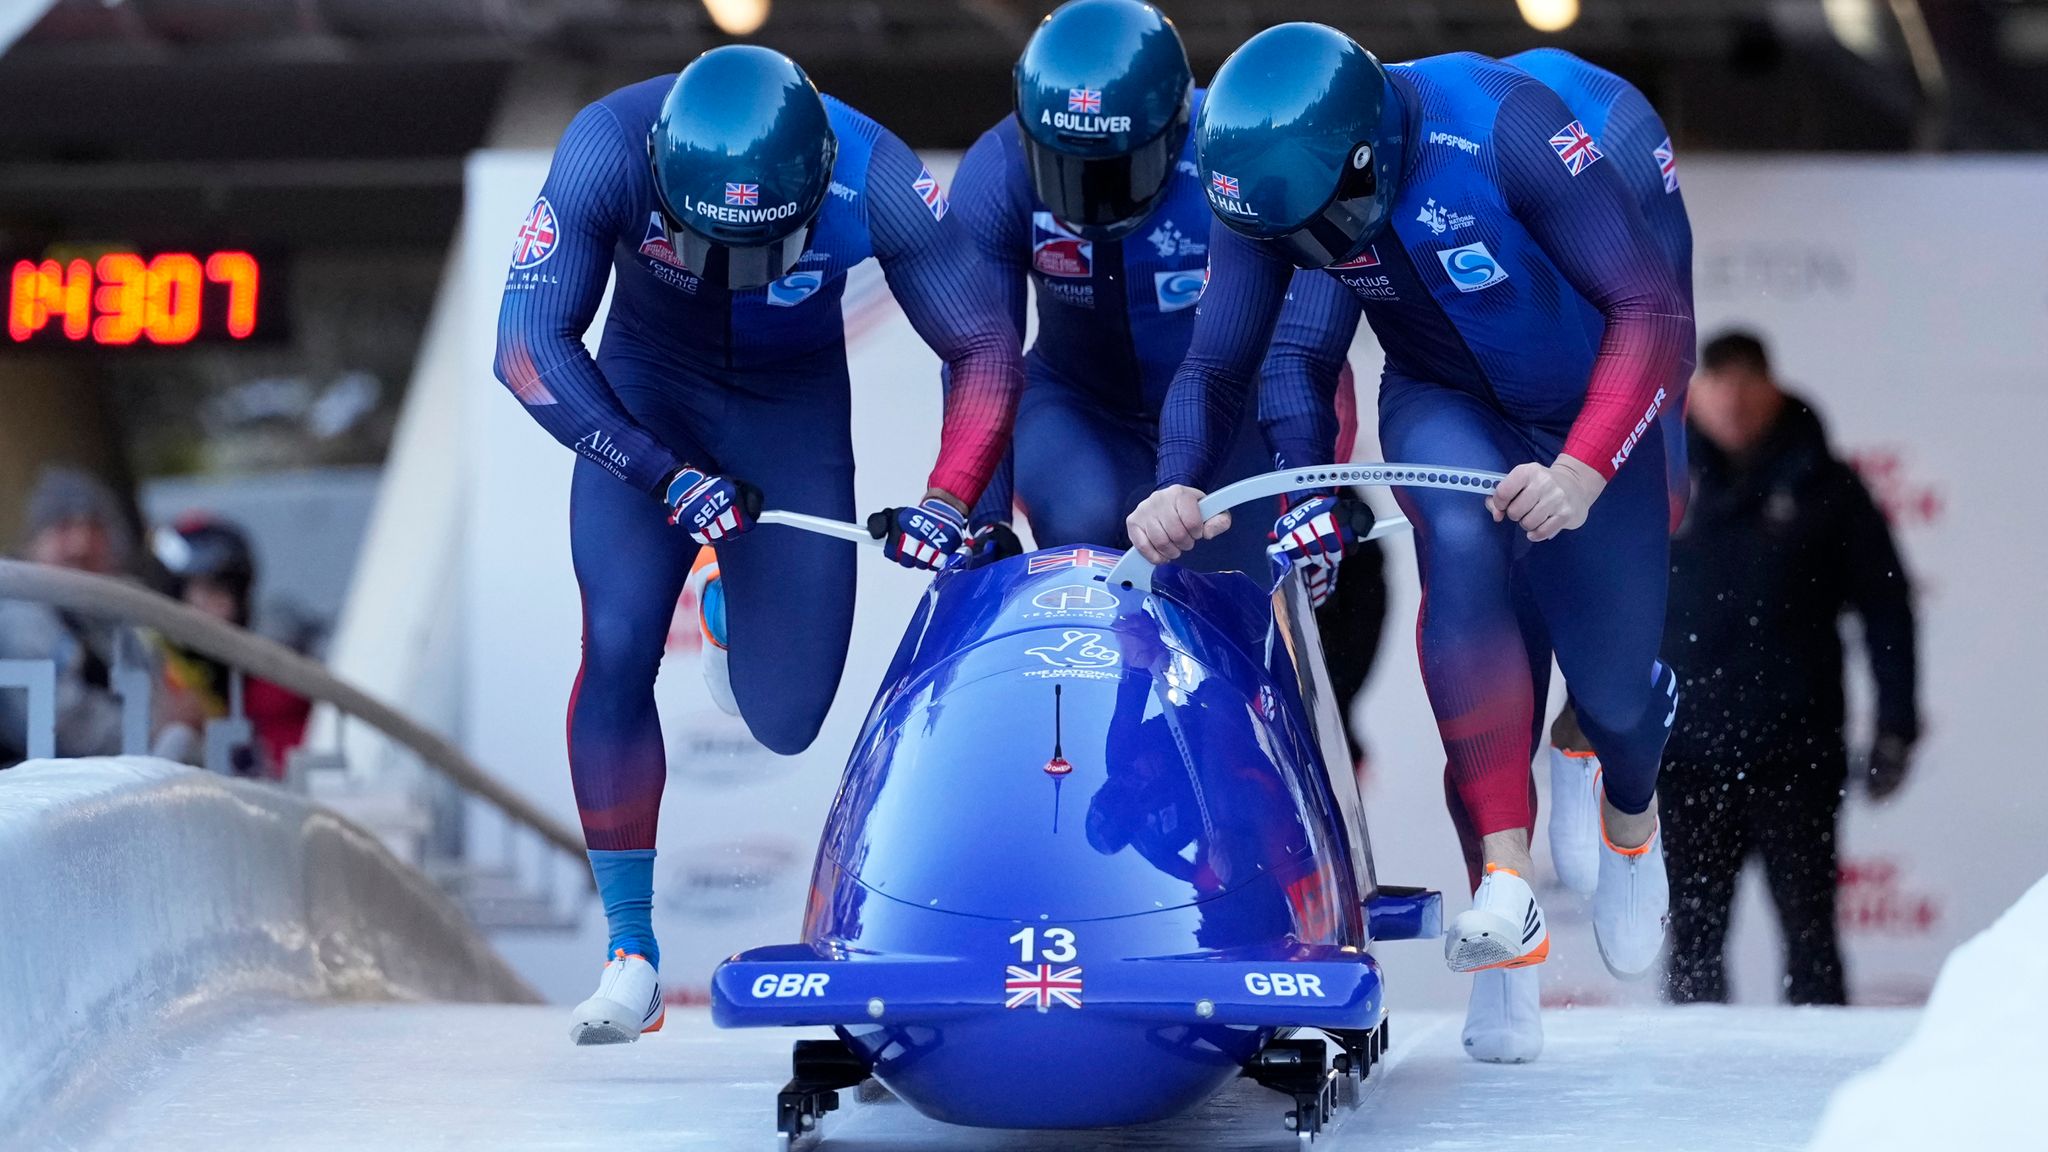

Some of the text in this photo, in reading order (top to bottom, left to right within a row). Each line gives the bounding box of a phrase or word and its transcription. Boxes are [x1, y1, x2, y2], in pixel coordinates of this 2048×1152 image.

[1041, 109, 1132, 133] A GULLIVER
[1430, 131, 1480, 156] IMPSPORT
[685, 194, 797, 223] L GREENWOOD
[1207, 188, 1259, 216] B HALL
[522, 272, 558, 284] HALL
[1341, 274, 1390, 288] fortius
[1356, 286, 1396, 297] clinic
[1611, 387, 1667, 471] KEISER
[574, 441, 629, 481] Consulting
[580, 429, 630, 468] Altus
[693, 490, 730, 528] SEIZ
[909, 514, 949, 549] SEIZ
[1053, 668, 1122, 679] NATIONAL
[1009, 926, 1077, 963] 13
[751, 972, 831, 999] GBR
[1244, 972, 1327, 998] GBR
